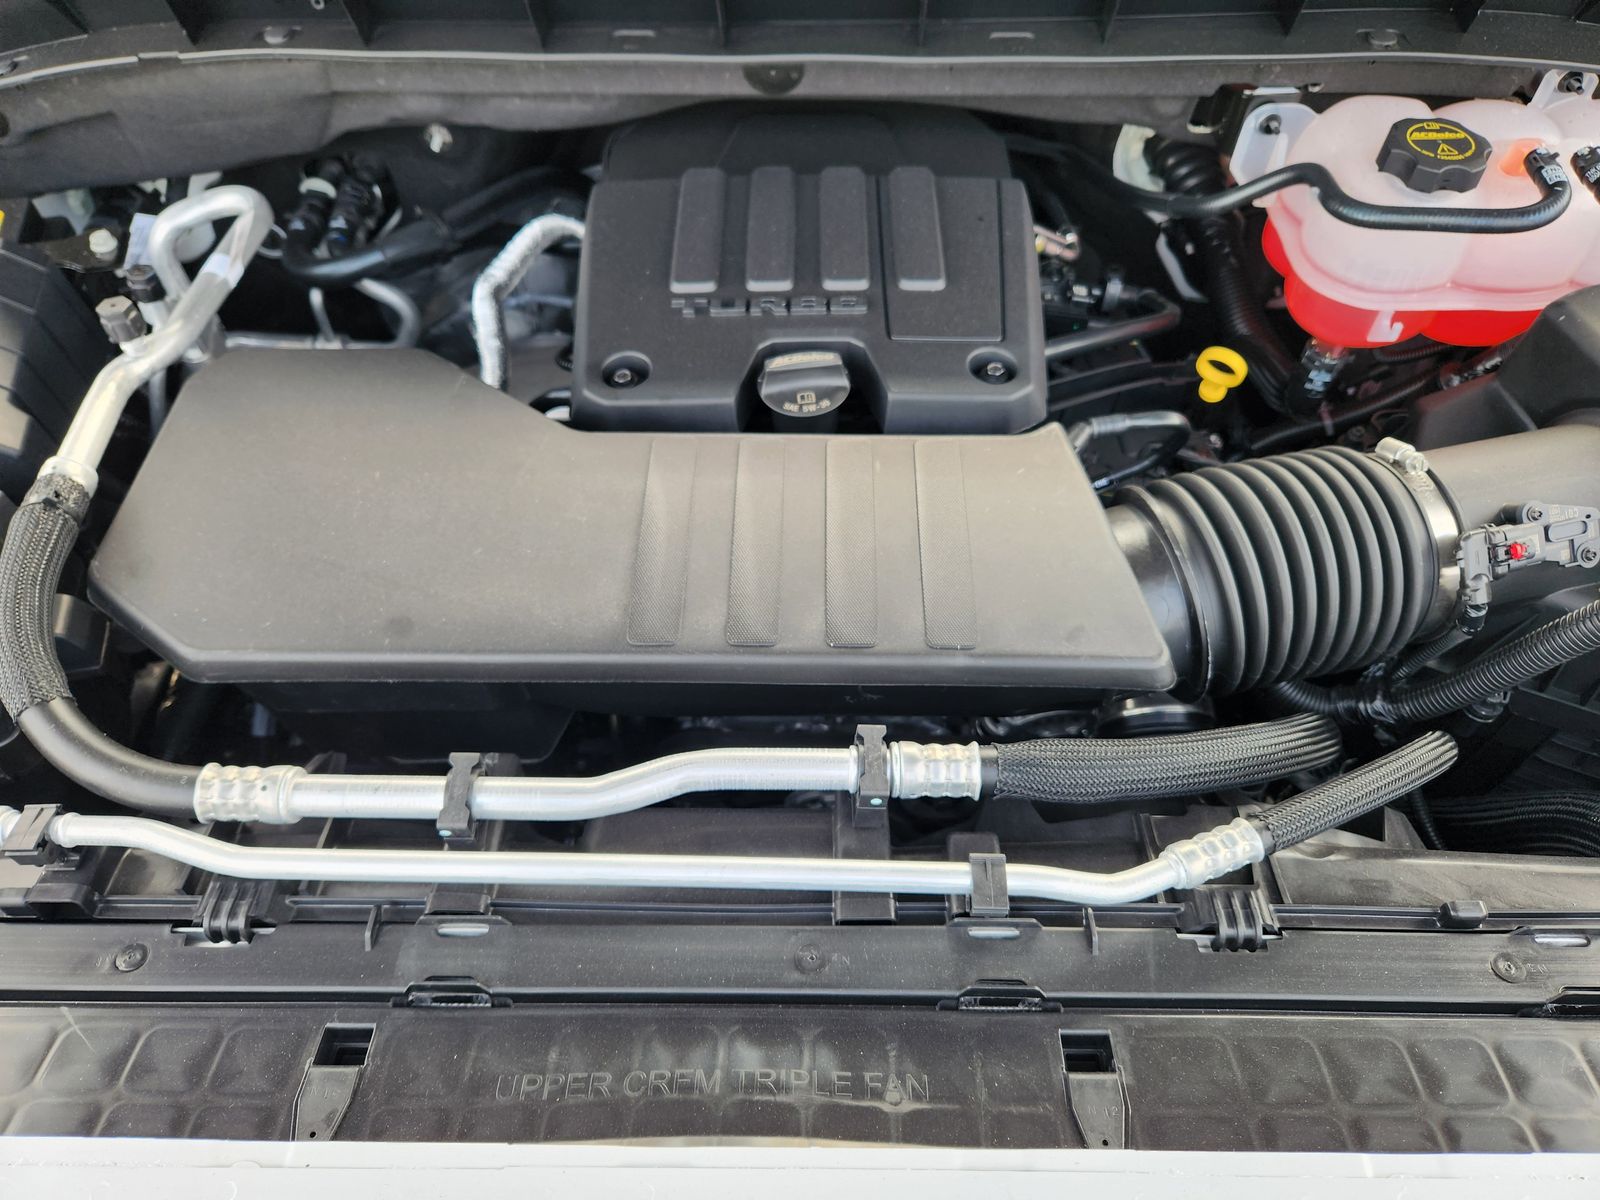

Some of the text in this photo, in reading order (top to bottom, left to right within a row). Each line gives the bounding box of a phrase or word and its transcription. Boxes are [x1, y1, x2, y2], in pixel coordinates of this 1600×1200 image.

[670, 297, 868, 318] TURBO
[783, 402, 800, 413] SAE
[495, 1068, 930, 1101] UPPER CRFM TRIPLE FAN
